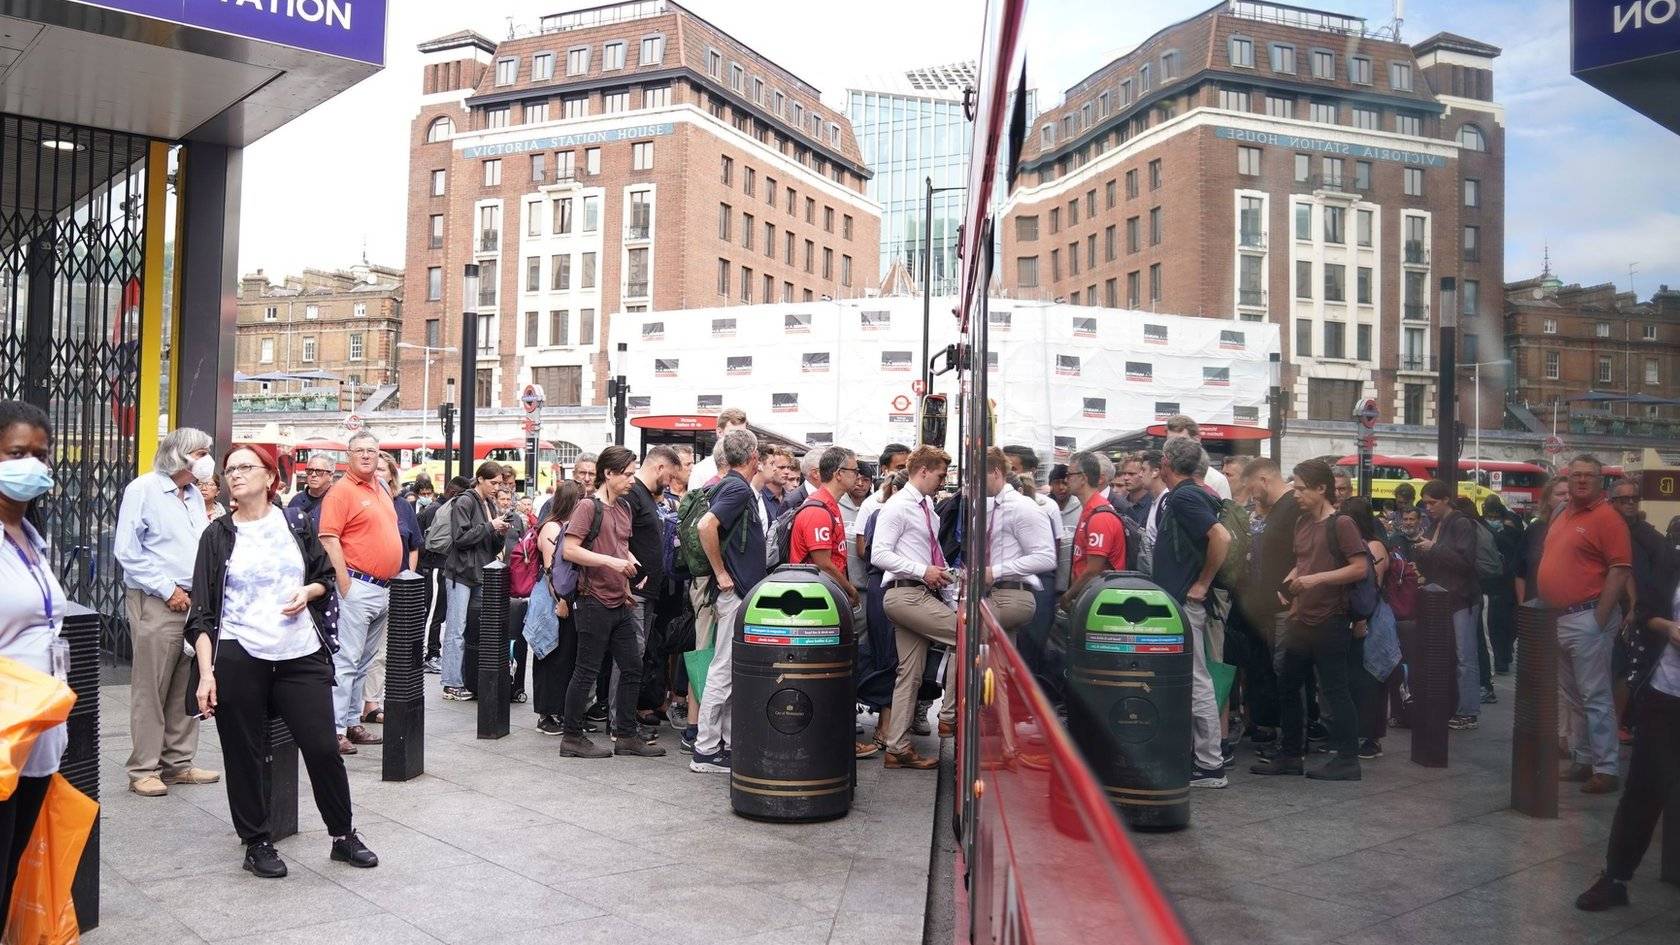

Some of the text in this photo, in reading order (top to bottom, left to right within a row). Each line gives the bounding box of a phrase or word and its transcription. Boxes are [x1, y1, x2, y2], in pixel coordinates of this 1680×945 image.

[473, 124, 665, 157] VICTORIA STATION HOUSE
[814, 527, 830, 542] IG
